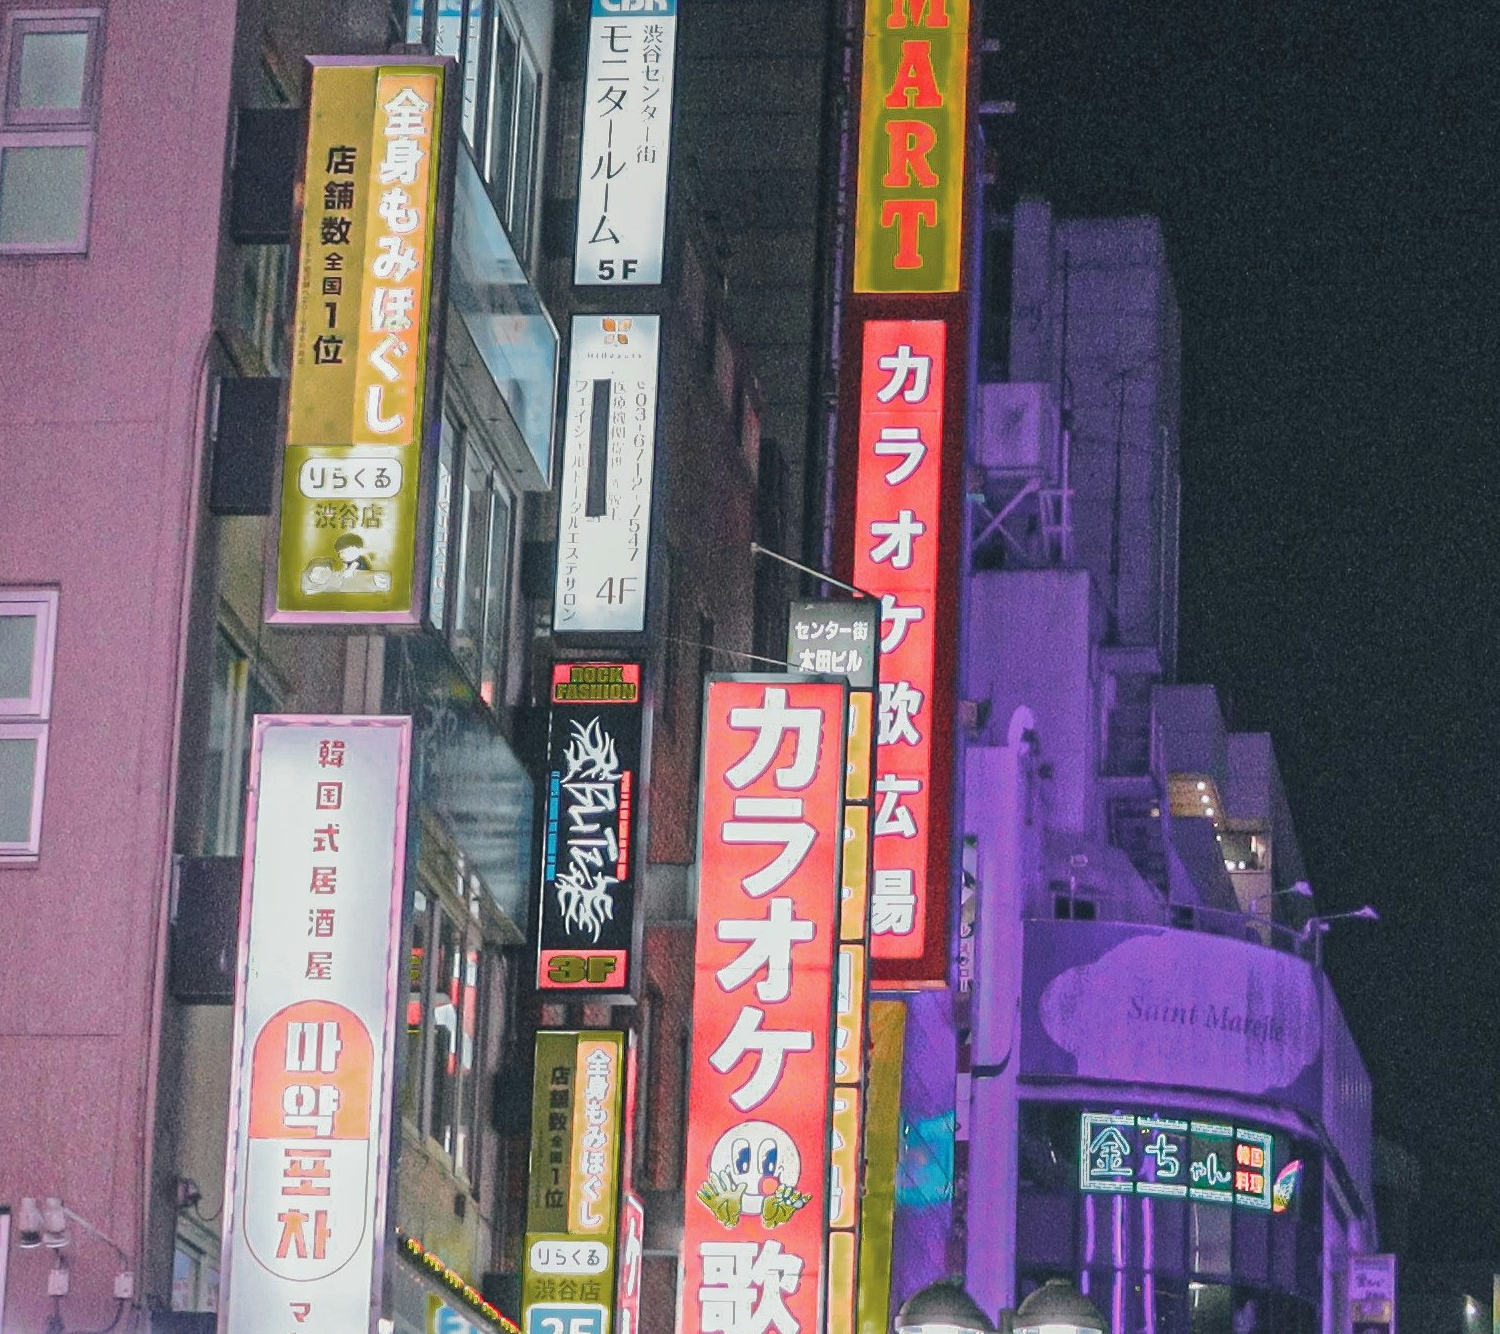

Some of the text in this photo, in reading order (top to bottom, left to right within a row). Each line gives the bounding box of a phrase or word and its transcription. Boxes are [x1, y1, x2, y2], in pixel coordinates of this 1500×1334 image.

[636, 23, 665, 165] 渋谷センター街
[587, 23, 633, 246] モニタールーム
[312, 143, 358, 365] 店舗数全国1位
[364, 87, 432, 433] 全身もみほぐし
[596, 259, 638, 281] 5F
[308, 463, 392, 492] りらくる
[313, 502, 384, 530] 渋谷店
[595, 576, 638, 606] 4F
[794, 619, 869, 642] センター街
[570, 666, 625, 683] ROCK
[556, 683, 637, 702] FASHION
[304, 739, 349, 982] 韓国式居酒屋
[706, 688, 825, 1113] カラオケ
[547, 954, 618, 984] 3F
[275, 1020, 344, 1261] 마약포차
[579, 1048, 612, 1227] 全身もみほぐし
[1235, 1170, 1265, 1194] 料理
[537, 1247, 602, 1268] りらくる
[534, 1279, 602, 1302] 渋谷店
